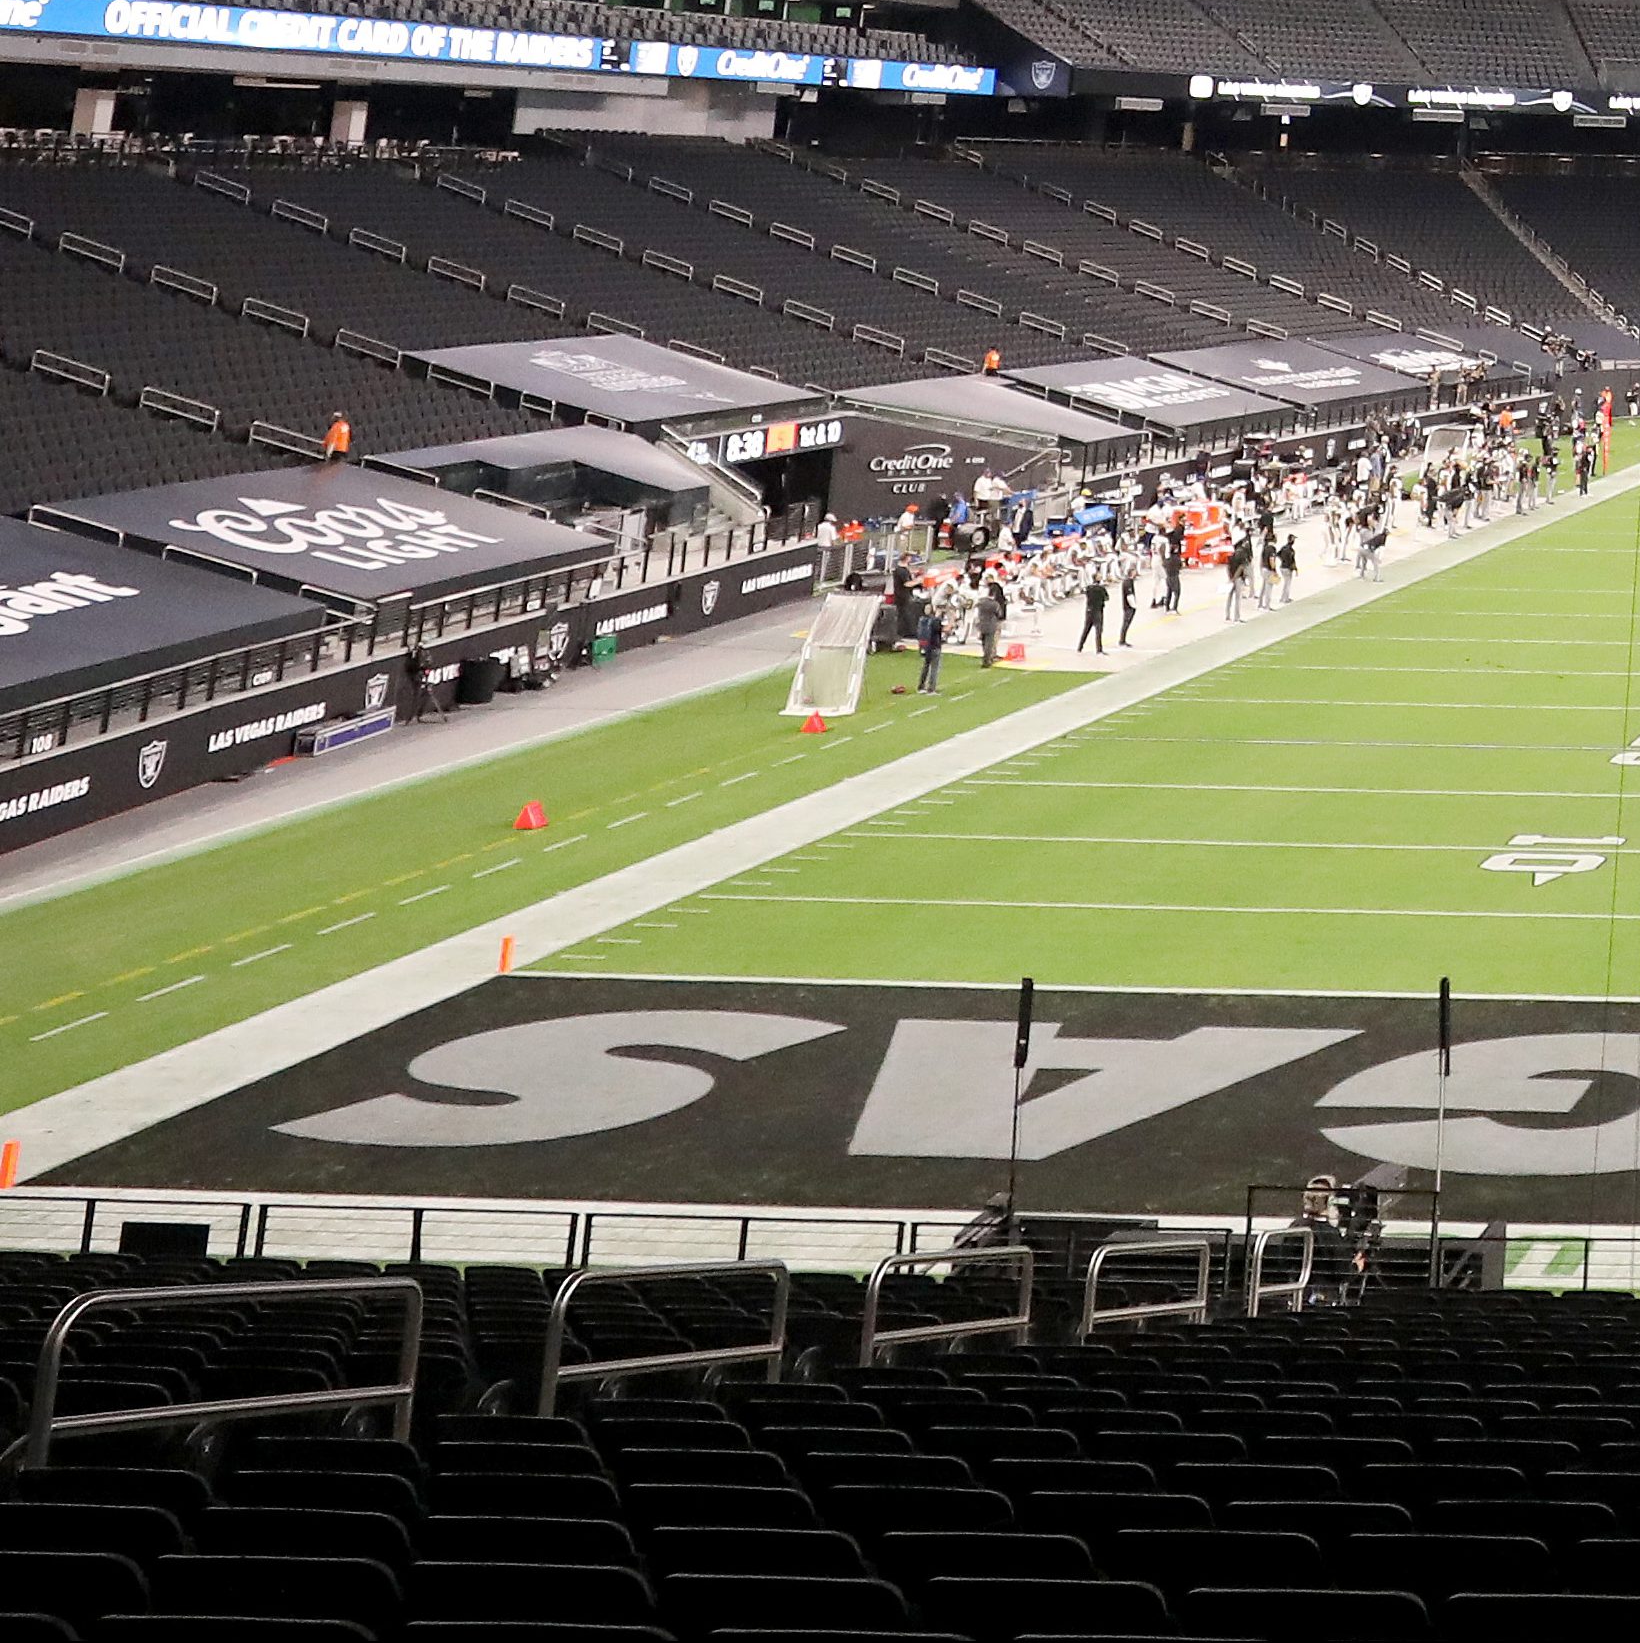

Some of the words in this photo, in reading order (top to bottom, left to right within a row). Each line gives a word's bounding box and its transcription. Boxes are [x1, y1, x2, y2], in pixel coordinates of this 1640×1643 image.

[338, 18, 410, 55] CARD
[410, 24, 448, 57] OF
[892, 484, 926, 494] CLUB
[168, 496, 447, 554] Coors
[310, 524, 505, 570] LIGHT
[31, 734, 53, 753] 108
[208, 729, 234, 753] LAS
[234, 717, 275, 745] VEGAS
[275, 702, 327, 733] RAIDERS
[27, 775, 91, 813] RAIDERS
[1479, 834, 1628, 873] 10
